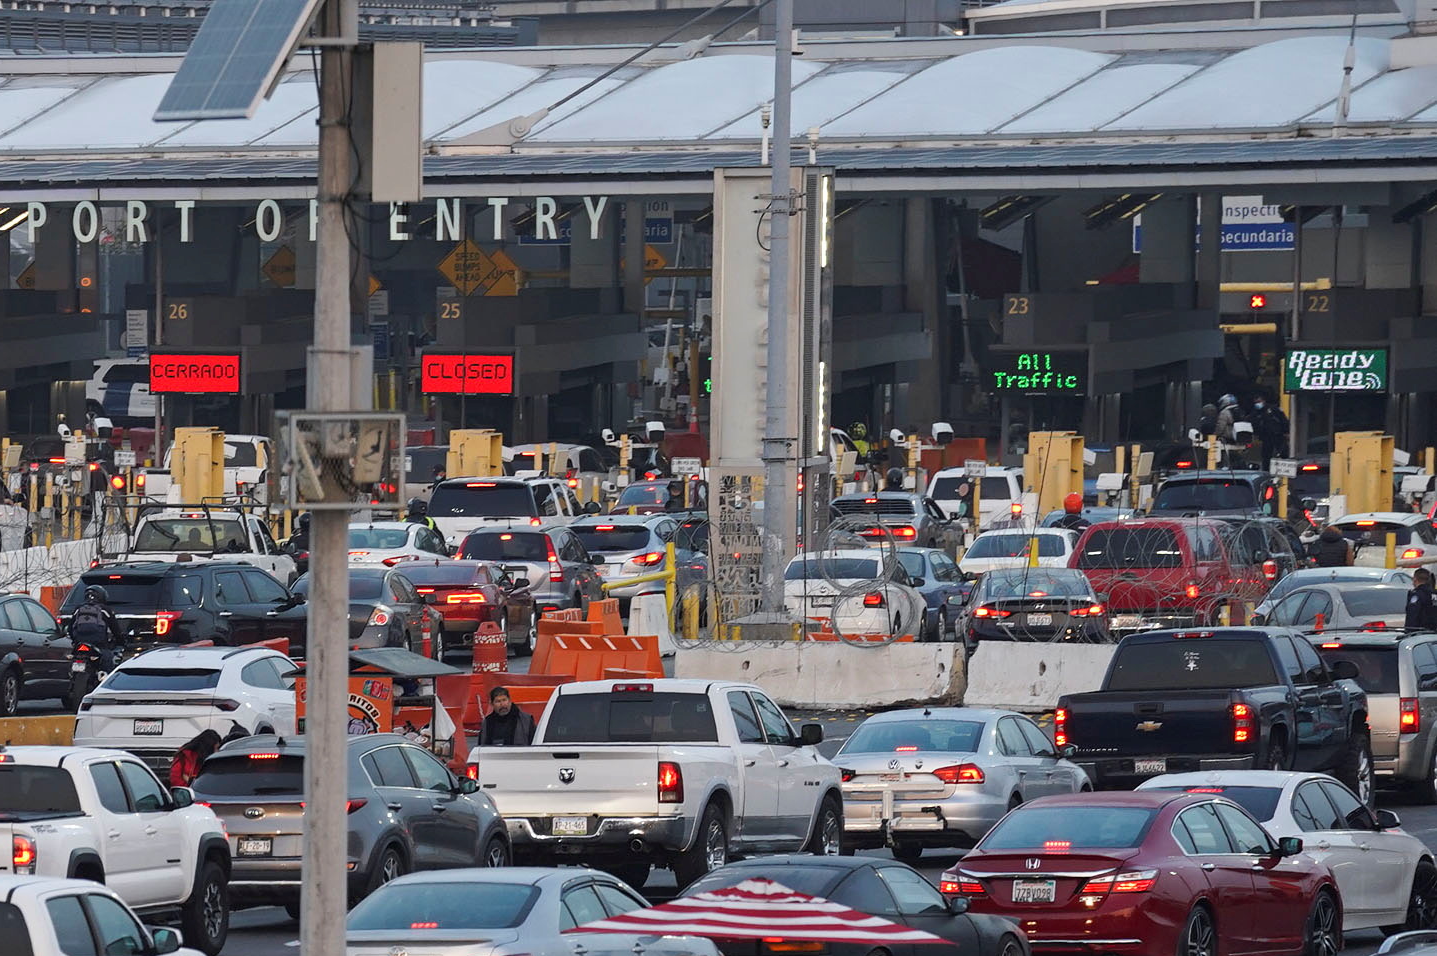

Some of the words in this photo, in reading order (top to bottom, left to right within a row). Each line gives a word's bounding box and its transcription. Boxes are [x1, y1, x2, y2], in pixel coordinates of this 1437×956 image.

[27, 200, 195, 244] PORT
[389, 196, 608, 241] ENTRY
[1224, 205, 1277, 221] nspecti
[168, 303, 188, 319] 26
[440, 302, 461, 319] 25
[1008, 298, 1030, 315] 23
[1308, 296, 1330, 313] 22
[1017, 354, 1052, 371] All
[1289, 351, 1375, 377] Ready
[151, 364, 236, 379] CERRADO
[426, 363, 508, 380] CLOSED
[993, 372, 1078, 389] Traffic
